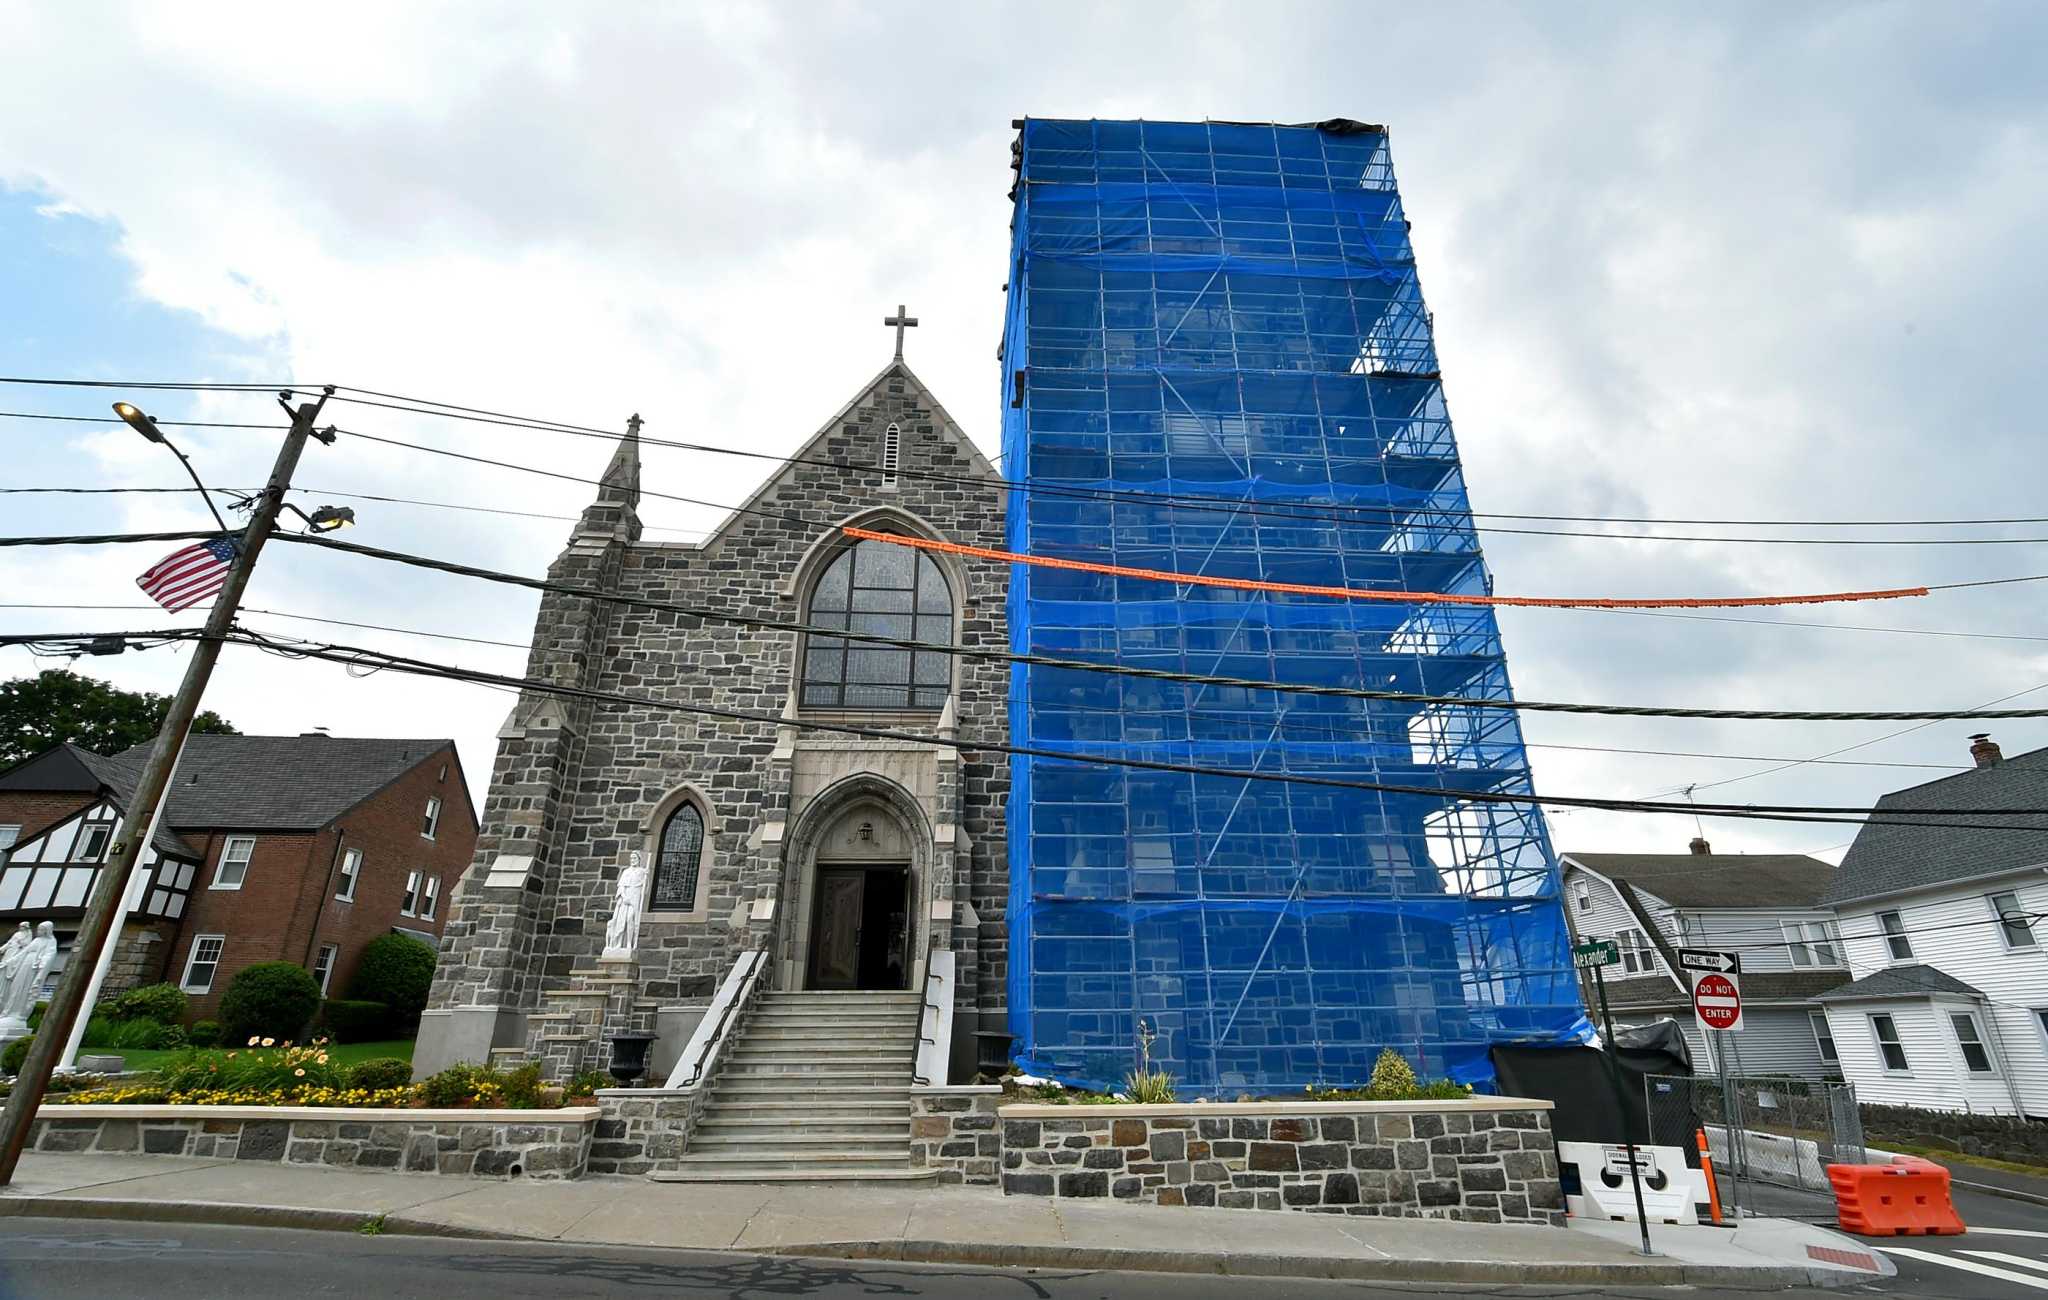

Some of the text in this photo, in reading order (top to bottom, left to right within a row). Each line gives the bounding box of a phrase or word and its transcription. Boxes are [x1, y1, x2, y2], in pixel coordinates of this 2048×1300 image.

[1573, 947, 1609, 968] Alexander
[1684, 955, 1720, 967] ONE WAY
[1700, 984, 1732, 994] DO NOT
[1705, 1008, 1732, 1018] ENTER
